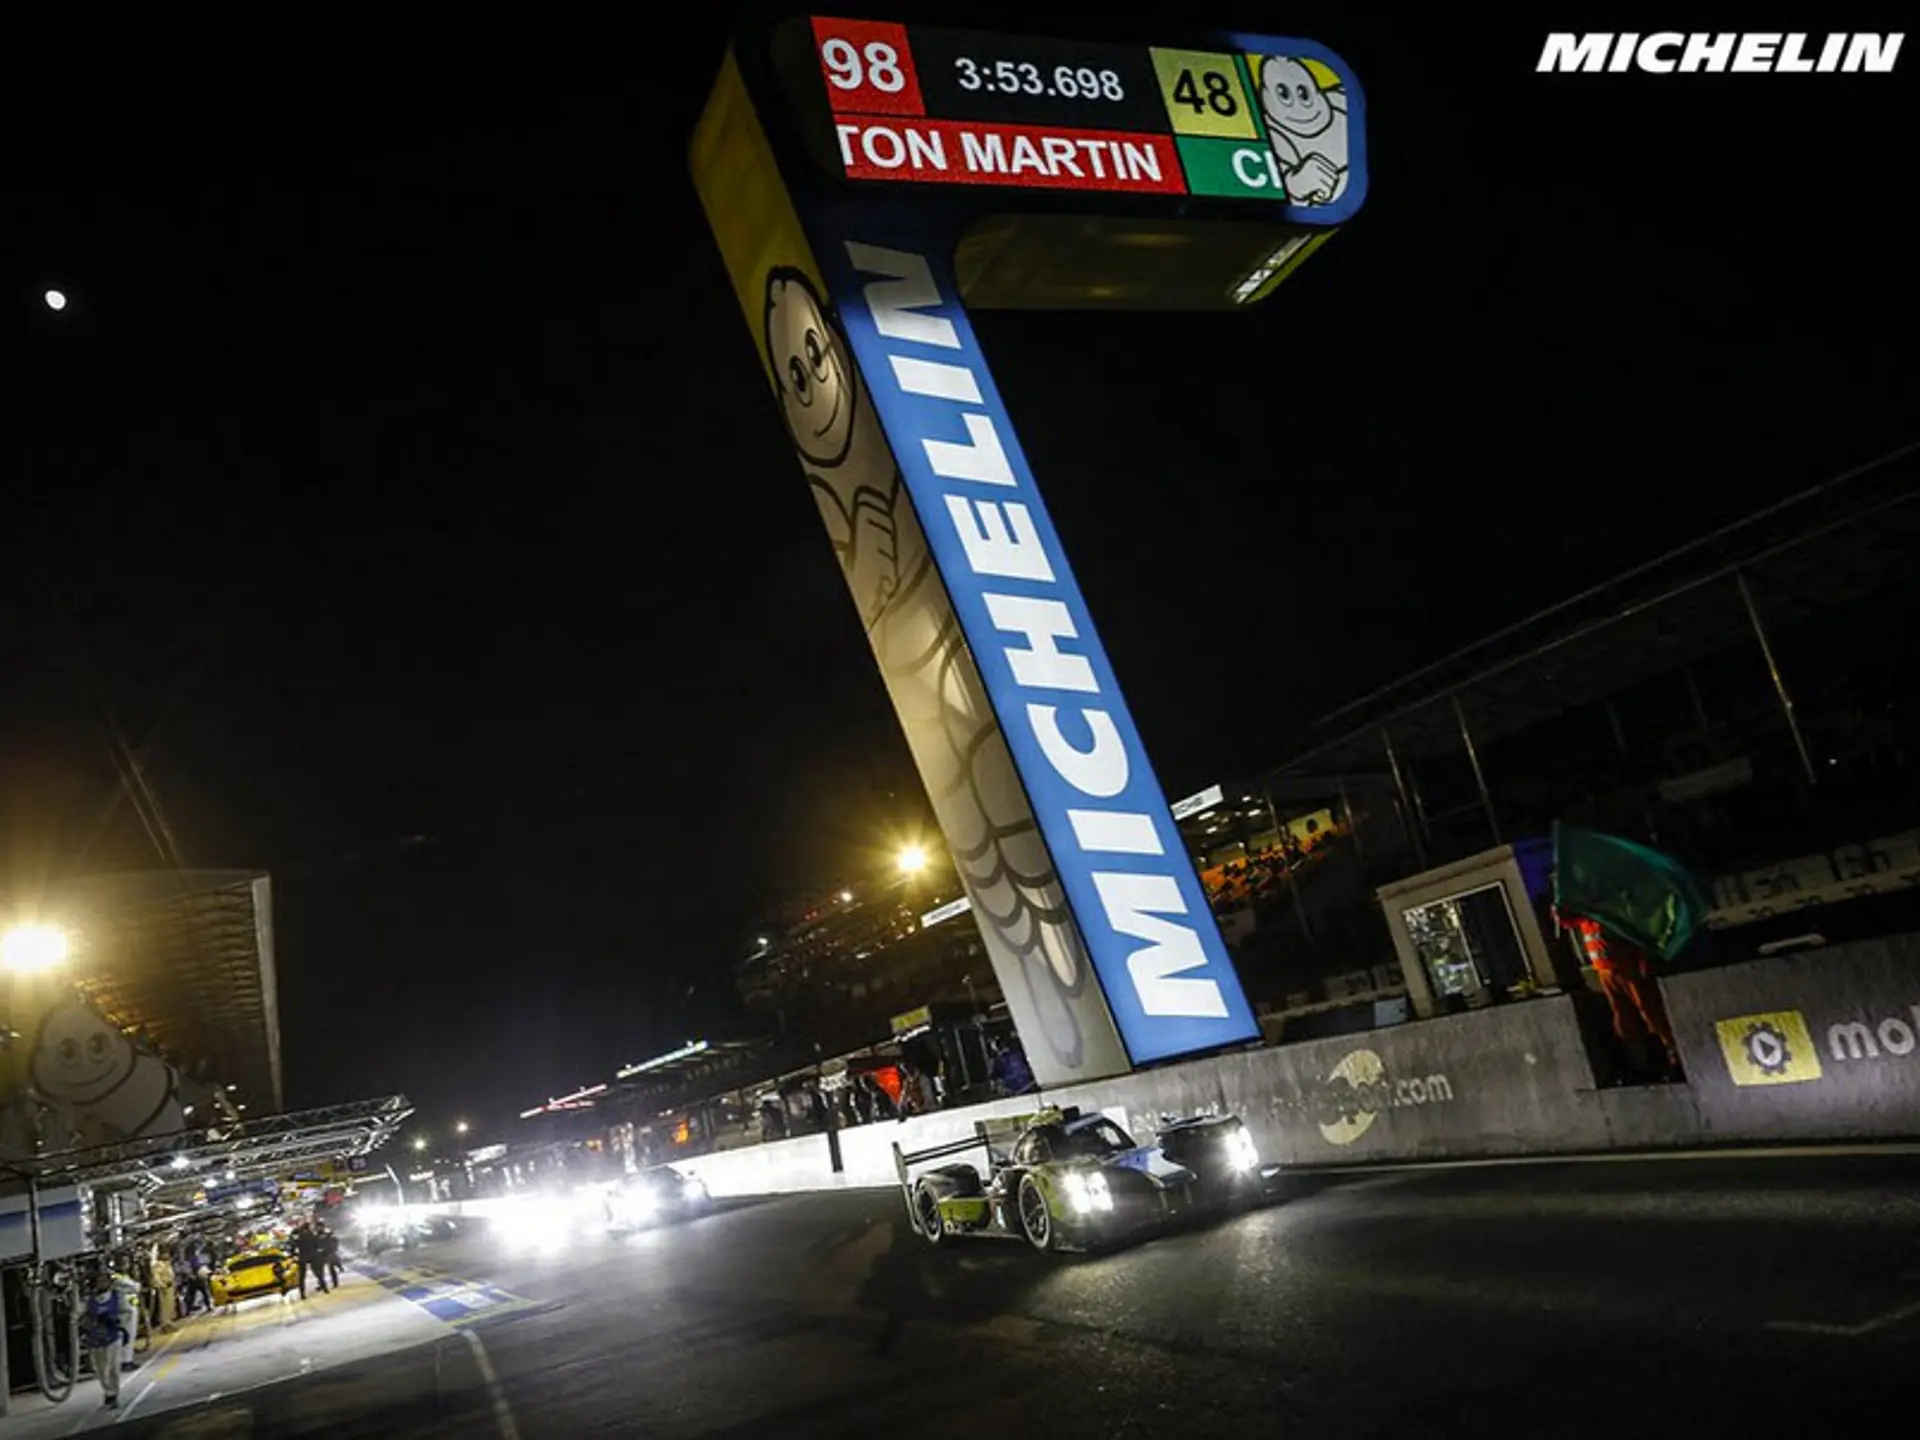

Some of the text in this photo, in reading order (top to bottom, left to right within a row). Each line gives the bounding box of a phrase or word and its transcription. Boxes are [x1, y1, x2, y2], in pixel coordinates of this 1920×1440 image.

[822, 38, 1238, 117] 98 3:53.698 48
[836, 124, 1163, 182] TON MARTIN
[843, 239, 1229, 1019] MICHELIN
